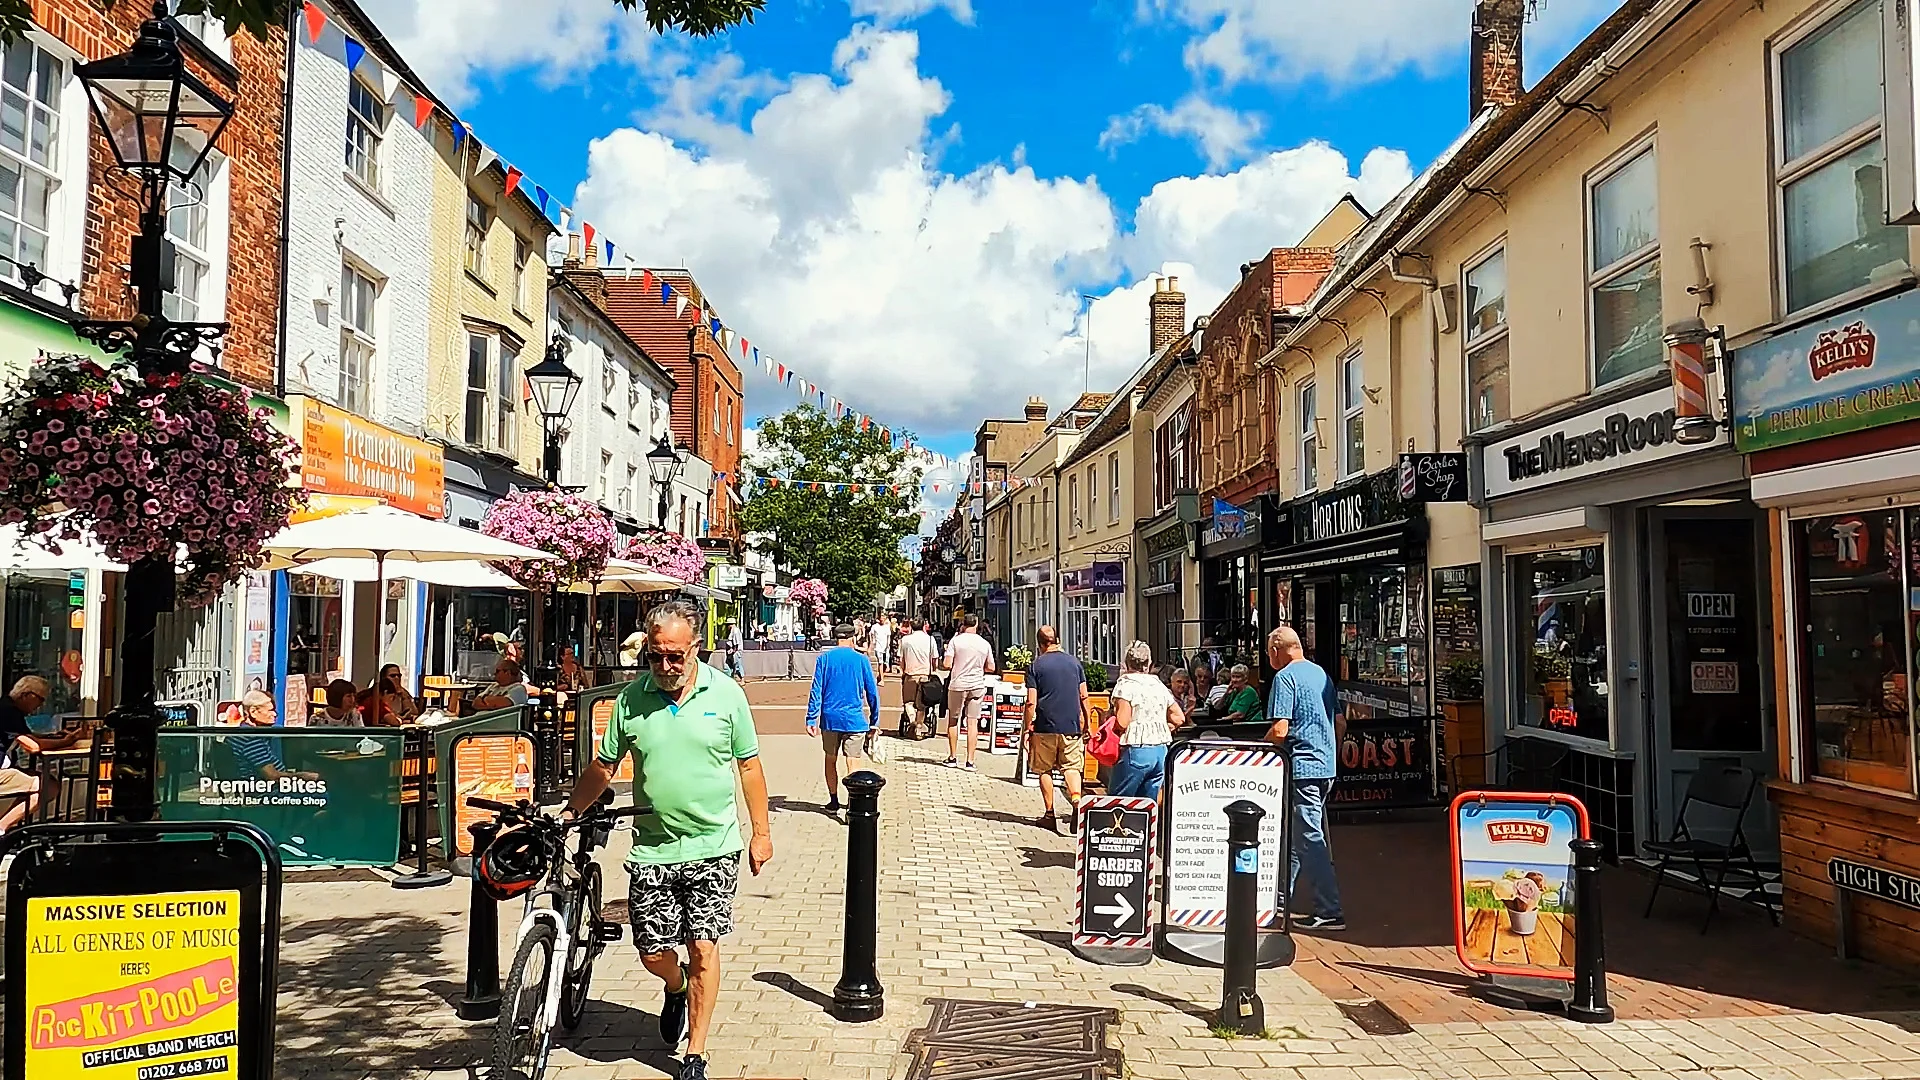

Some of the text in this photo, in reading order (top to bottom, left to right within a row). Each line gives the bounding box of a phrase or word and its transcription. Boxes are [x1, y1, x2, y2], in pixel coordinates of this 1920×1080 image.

[1815, 338, 1869, 369] KELLY'S
[1769, 404, 1811, 433] PERI
[1814, 395, 1846, 424] ICE
[1418, 455, 1458, 476] Barber
[344, 456, 359, 484] The
[361, 460, 397, 493] Sandwich
[399, 472, 416, 501] Shop
[1425, 469, 1455, 487] Shop
[1312, 494, 1363, 540] HORTONS
[1095, 578, 1122, 587] rubicon
[1690, 595, 1732, 617] OPEN
[1693, 664, 1736, 679] OPEN
[1549, 707, 1578, 727] OPEN
[199, 776, 327, 793] Premier Bites
[1343, 773, 1377, 783] crackling
[1379, 772, 1393, 780] bits
[1402, 771, 1422, 781] gravy
[1177, 778, 1279, 798] THE MENS ROOM
[1335, 789, 1360, 801] ALL
[199, 796, 327, 807] Sandwich Bar & Coffee Shop
[1491, 823, 1545, 838] KELLY'S
[1089, 856, 1143, 873] BARBER
[1097, 872, 1134, 888] SHOP
[1834, 862, 1880, 892] HIGH
[45, 900, 227, 922] MASSIVE SELECTION
[30, 928, 239, 954] ALL GENRES OF MUSIC
[120, 962, 150, 976] HERE'S
[84, 1032, 236, 1066] OFFICIAL BAND MERCH
[139, 1056, 227, 1080] 01202 668 701
